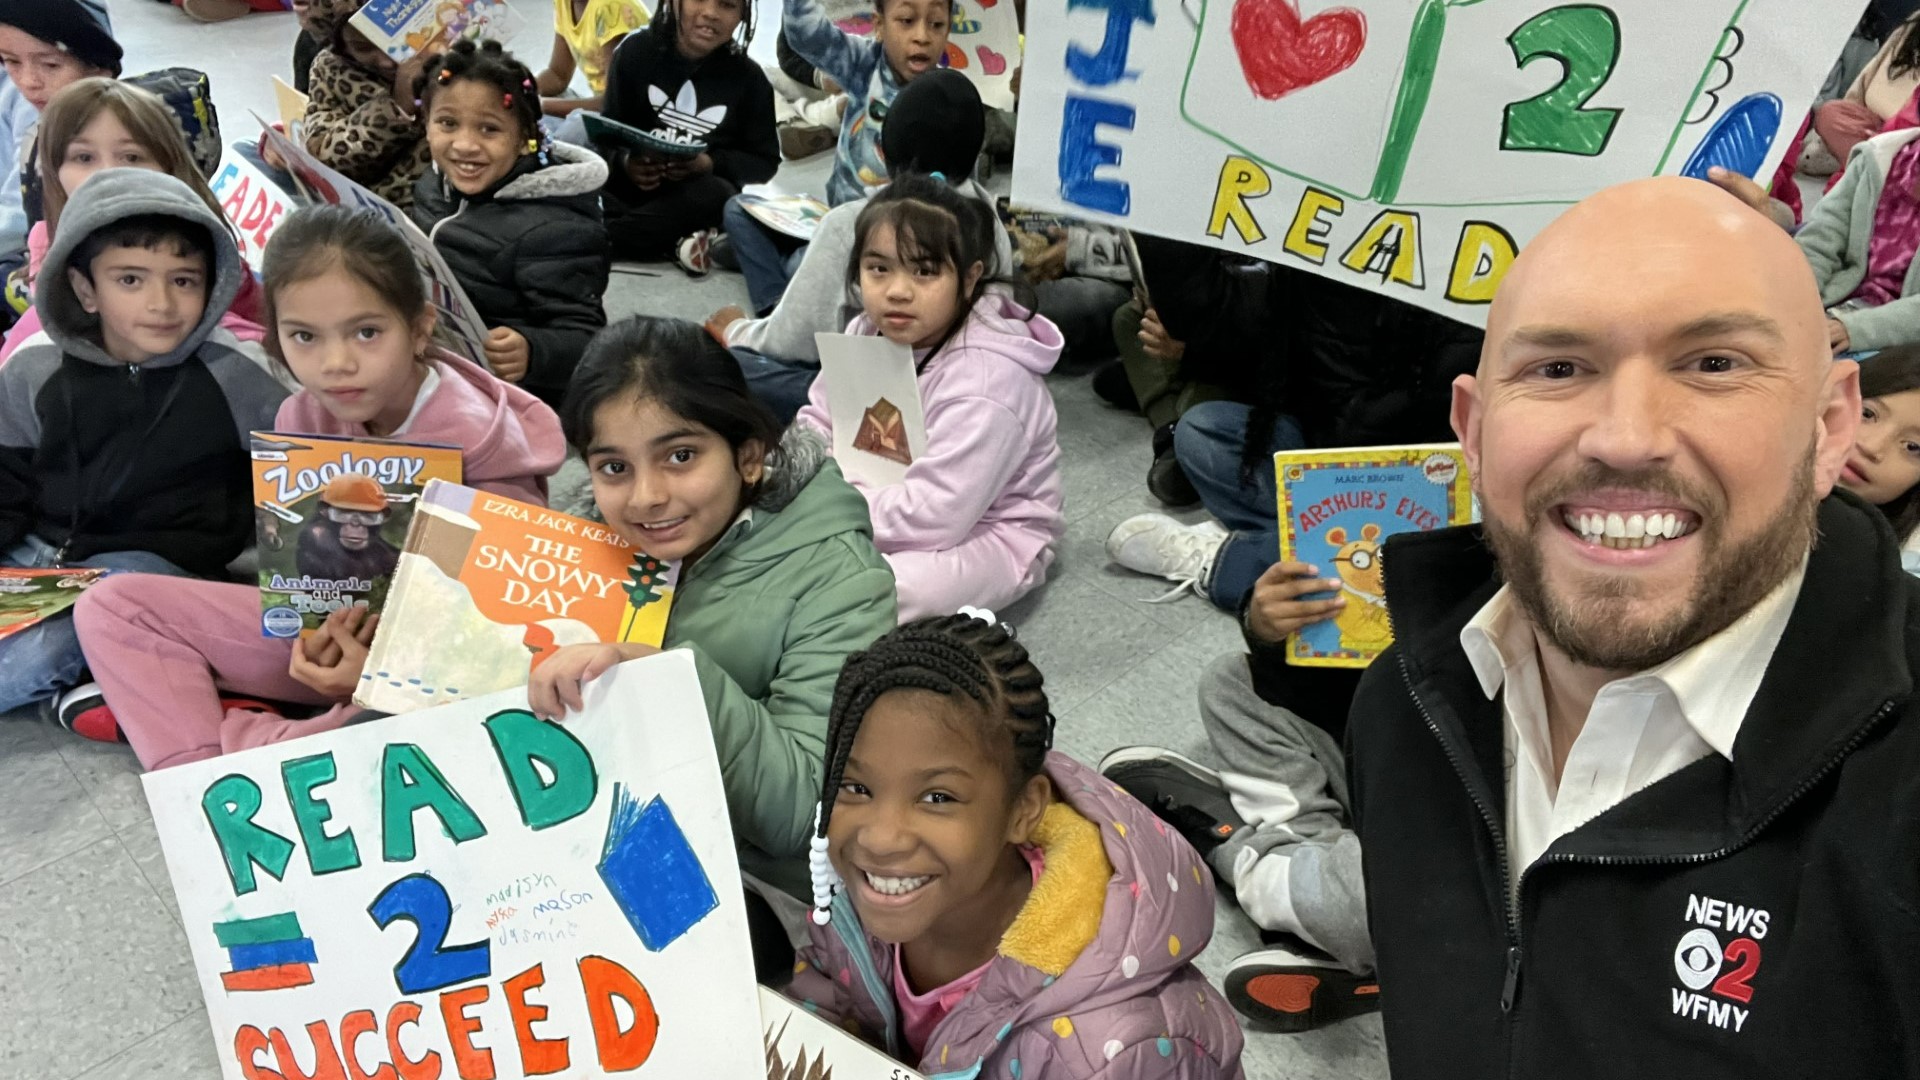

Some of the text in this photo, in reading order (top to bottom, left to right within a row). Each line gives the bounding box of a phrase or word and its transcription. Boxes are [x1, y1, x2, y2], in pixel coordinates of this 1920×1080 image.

[1499, 4, 1624, 157] 2
[1206, 154, 1520, 304] READ
[263, 452, 425, 503] Zoology
[1335, 473, 1404, 484] MARC BROWN
[482, 499, 529, 522] EZRA
[532, 513, 577, 534] JACK
[1299, 490, 1440, 533] ARTHUR'S EYES
[475, 545, 621, 599] SNOWY
[524, 534, 582, 564] THE
[270, 574, 372, 591] Animals
[313, 587, 340, 600] and
[501, 578, 582, 617] DAY
[202, 709, 599, 896] READ
[367, 872, 492, 995] 2
[1684, 893, 1771, 939] NEWS
[1711, 938, 1761, 1003] 2
[234, 955, 660, 1080] SUCCEED
[1671, 987, 1749, 1033] WFMY
